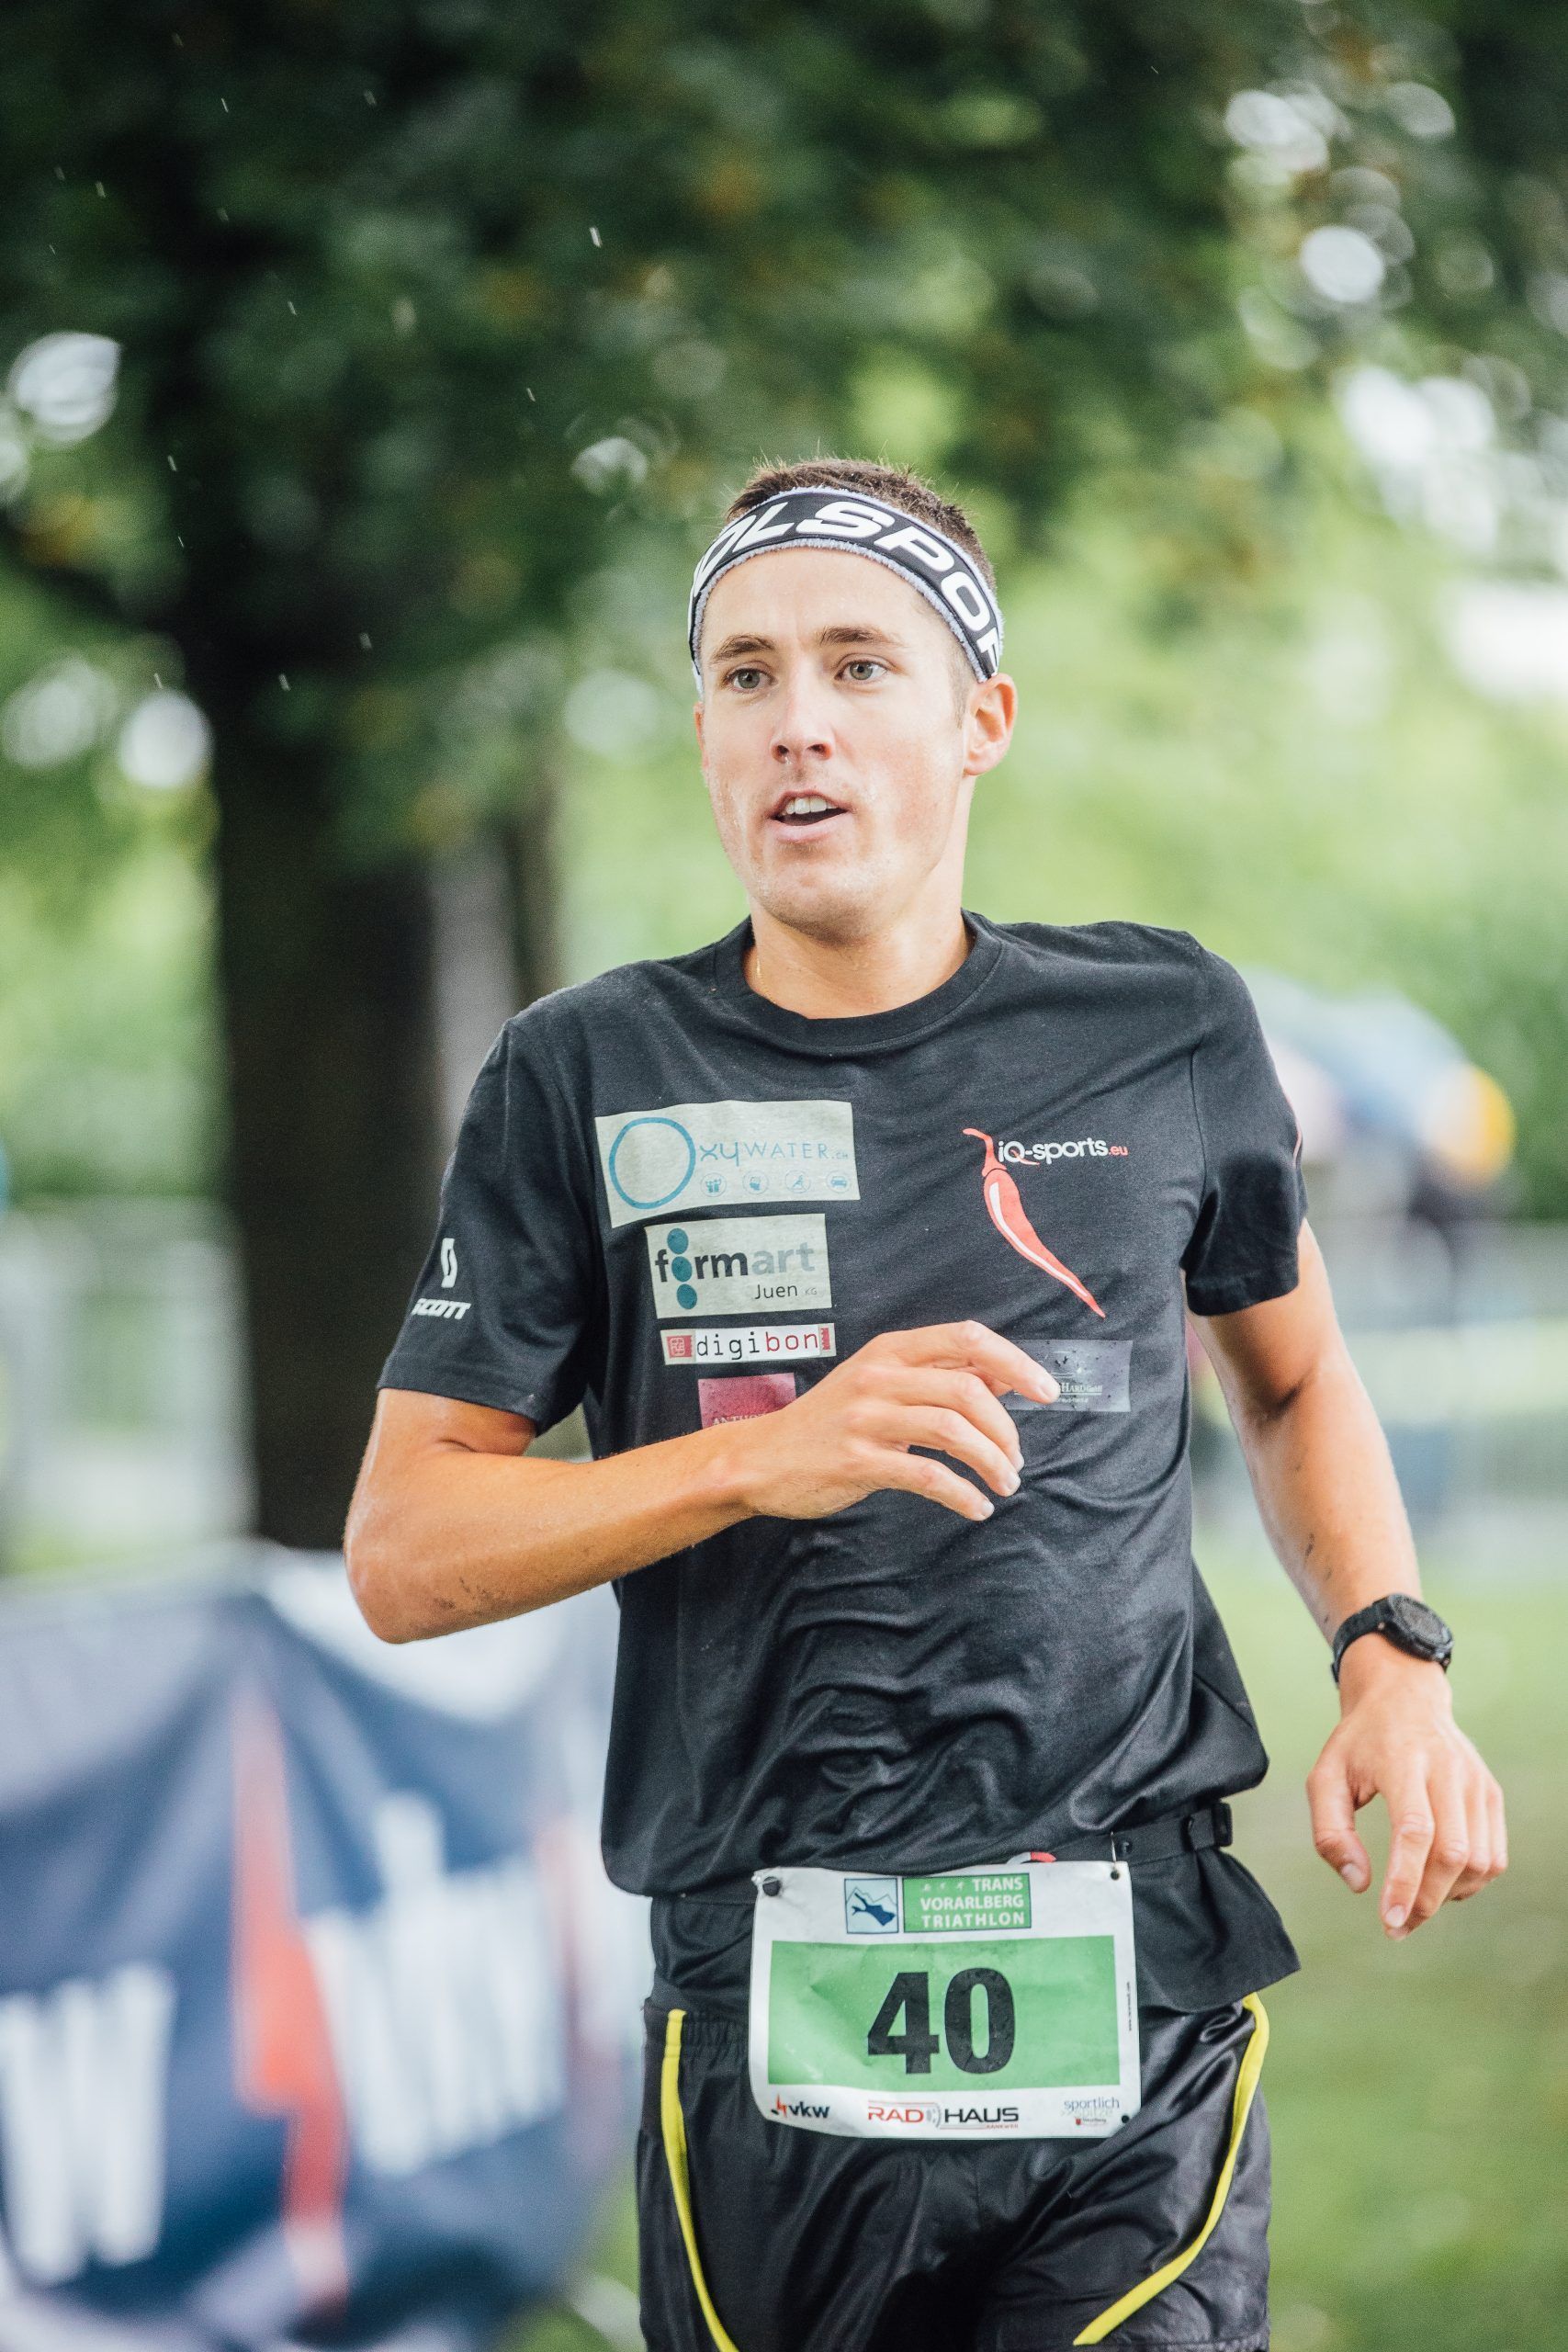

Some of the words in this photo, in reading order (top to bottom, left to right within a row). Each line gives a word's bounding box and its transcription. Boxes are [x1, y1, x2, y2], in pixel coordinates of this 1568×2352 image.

[755, 1284, 797, 1299] Juen
[411, 1298, 472, 1320] SCOTT
[696, 1331, 818, 1360] digibon
[972, 1877, 1024, 1892] TRANS
[920, 1894, 1024, 1911] VORARLBERG
[922, 1912, 1025, 1928] TRIATHLON
[867, 1967, 1016, 2075] 40
[788, 2101, 830, 2119] vkw
[1064, 2097, 1120, 2111] sportlich
